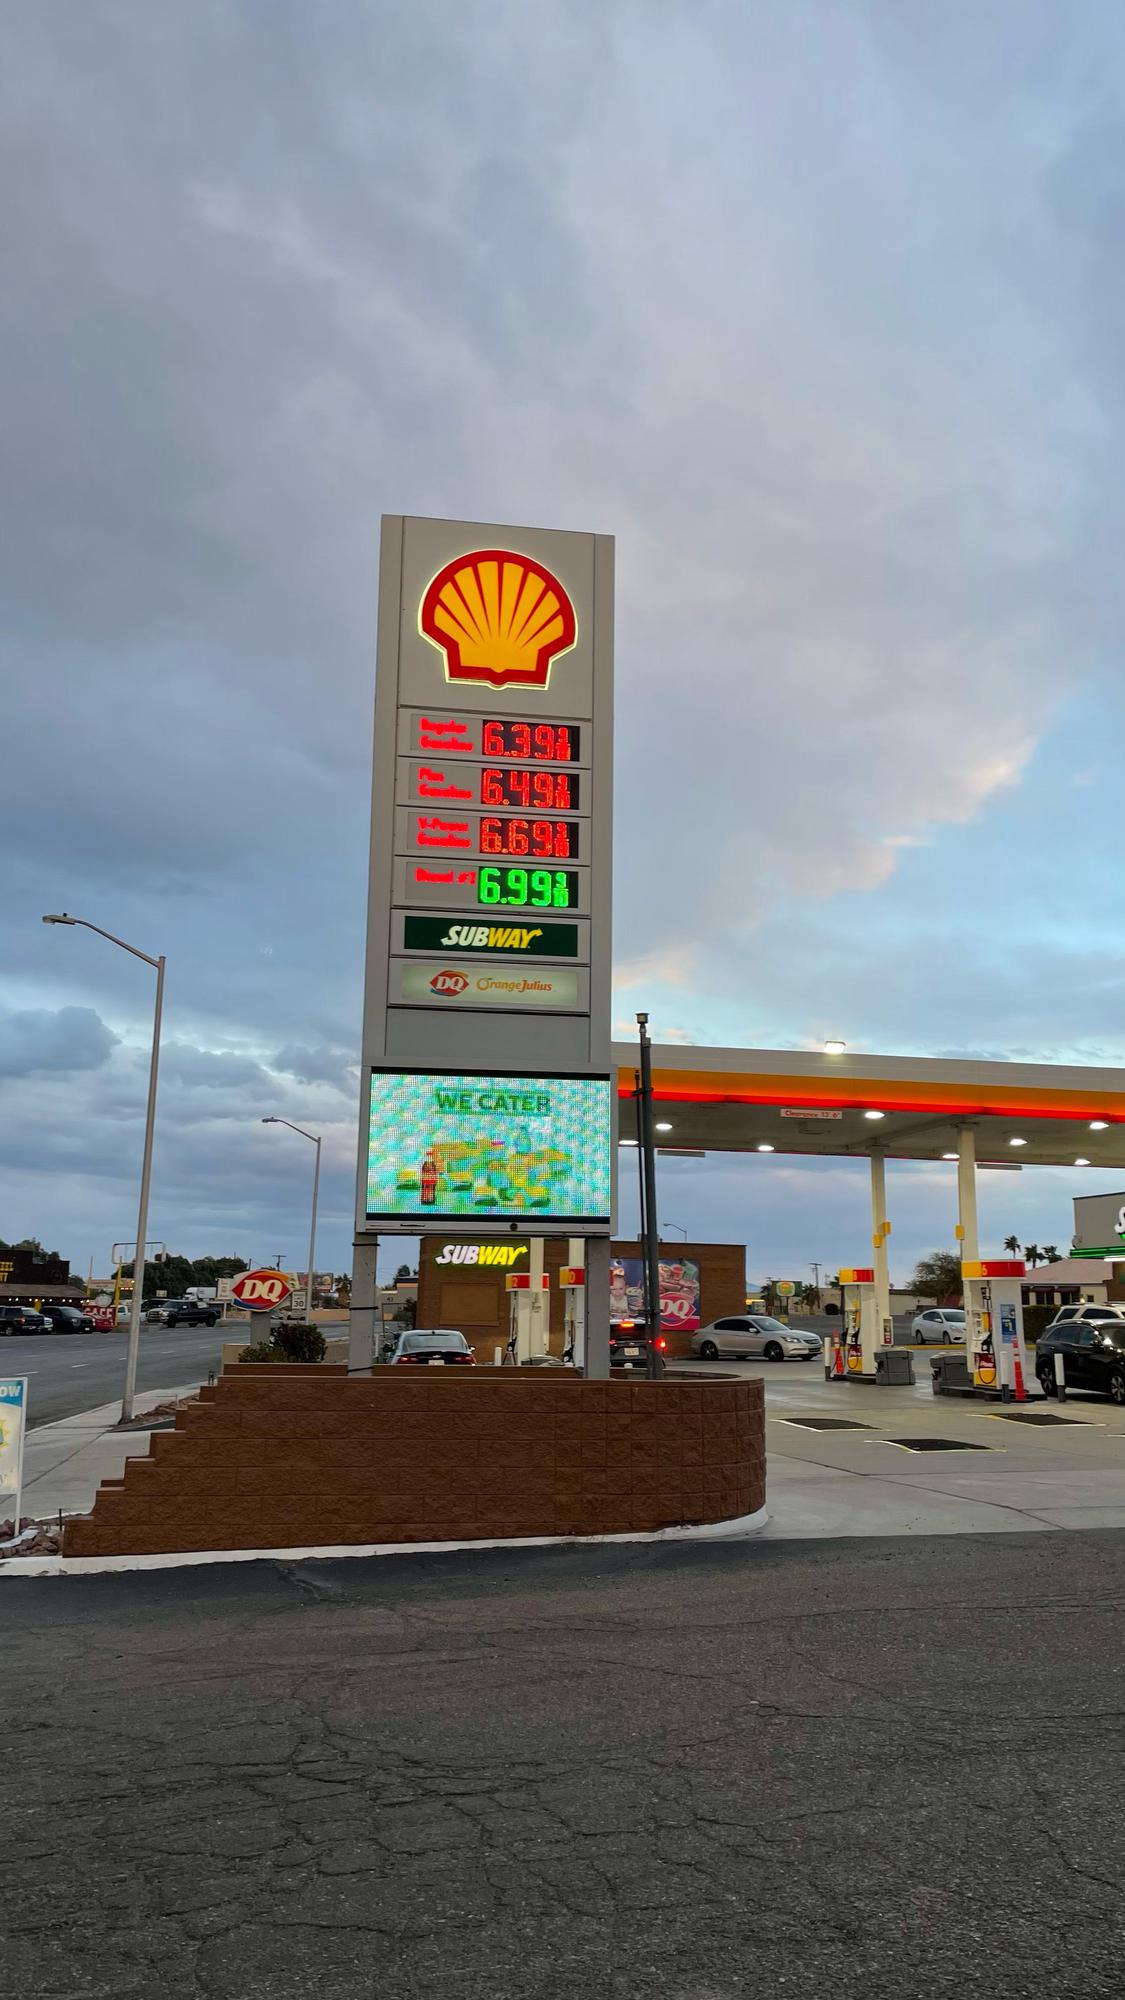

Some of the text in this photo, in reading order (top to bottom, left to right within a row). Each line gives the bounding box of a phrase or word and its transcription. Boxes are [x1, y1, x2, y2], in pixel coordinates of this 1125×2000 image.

[484, 722, 555, 760] 6.39
[482, 769, 554, 808] 6.49
[481, 818, 553, 856] 6.69
[480, 867, 552, 906] 6.99
[440, 926, 544, 949] SUBWAY
[435, 975, 465, 992] DQ
[435, 1092, 551, 1111] WE CATER
[435, 1244, 528, 1265] SUBWAY
[240, 1279, 283, 1303] DQ
[660, 1299, 689, 1319] DQ
